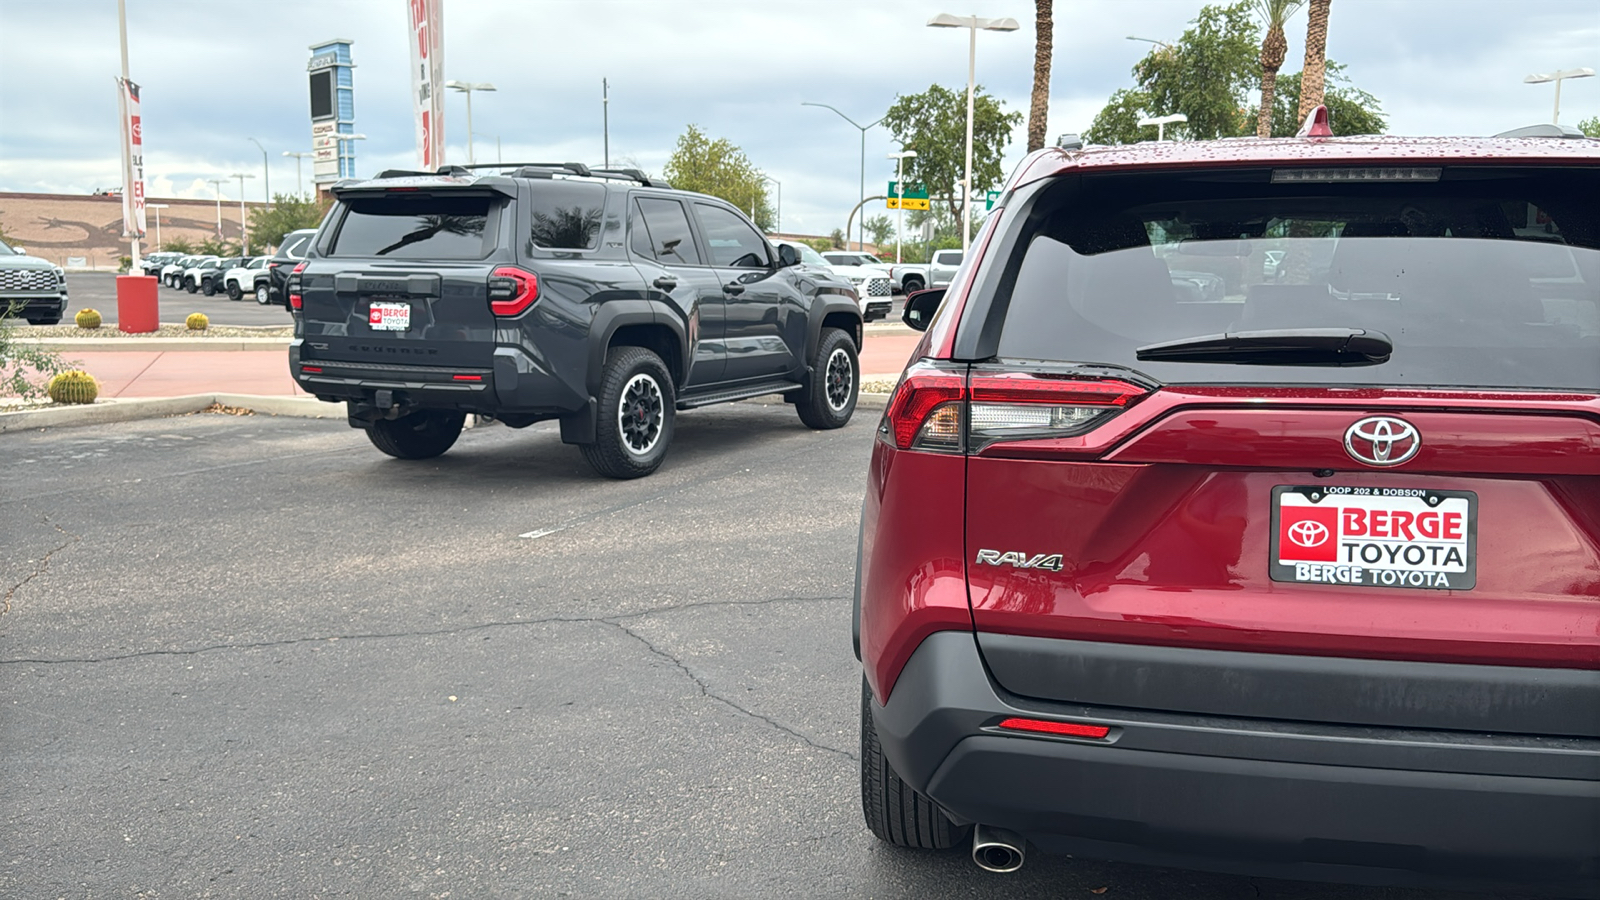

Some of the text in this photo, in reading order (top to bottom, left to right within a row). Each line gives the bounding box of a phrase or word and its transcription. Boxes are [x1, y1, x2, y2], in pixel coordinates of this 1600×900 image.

[383, 308, 409, 318] BERGE
[1323, 486, 1426, 498] LOOP 202 & DOBSON
[1342, 507, 1463, 542] BERGE
[975, 548, 1064, 572] RAV4
[1342, 542, 1464, 567] TOYOTA
[1295, 563, 1450, 588] BERGE TOYOTA
